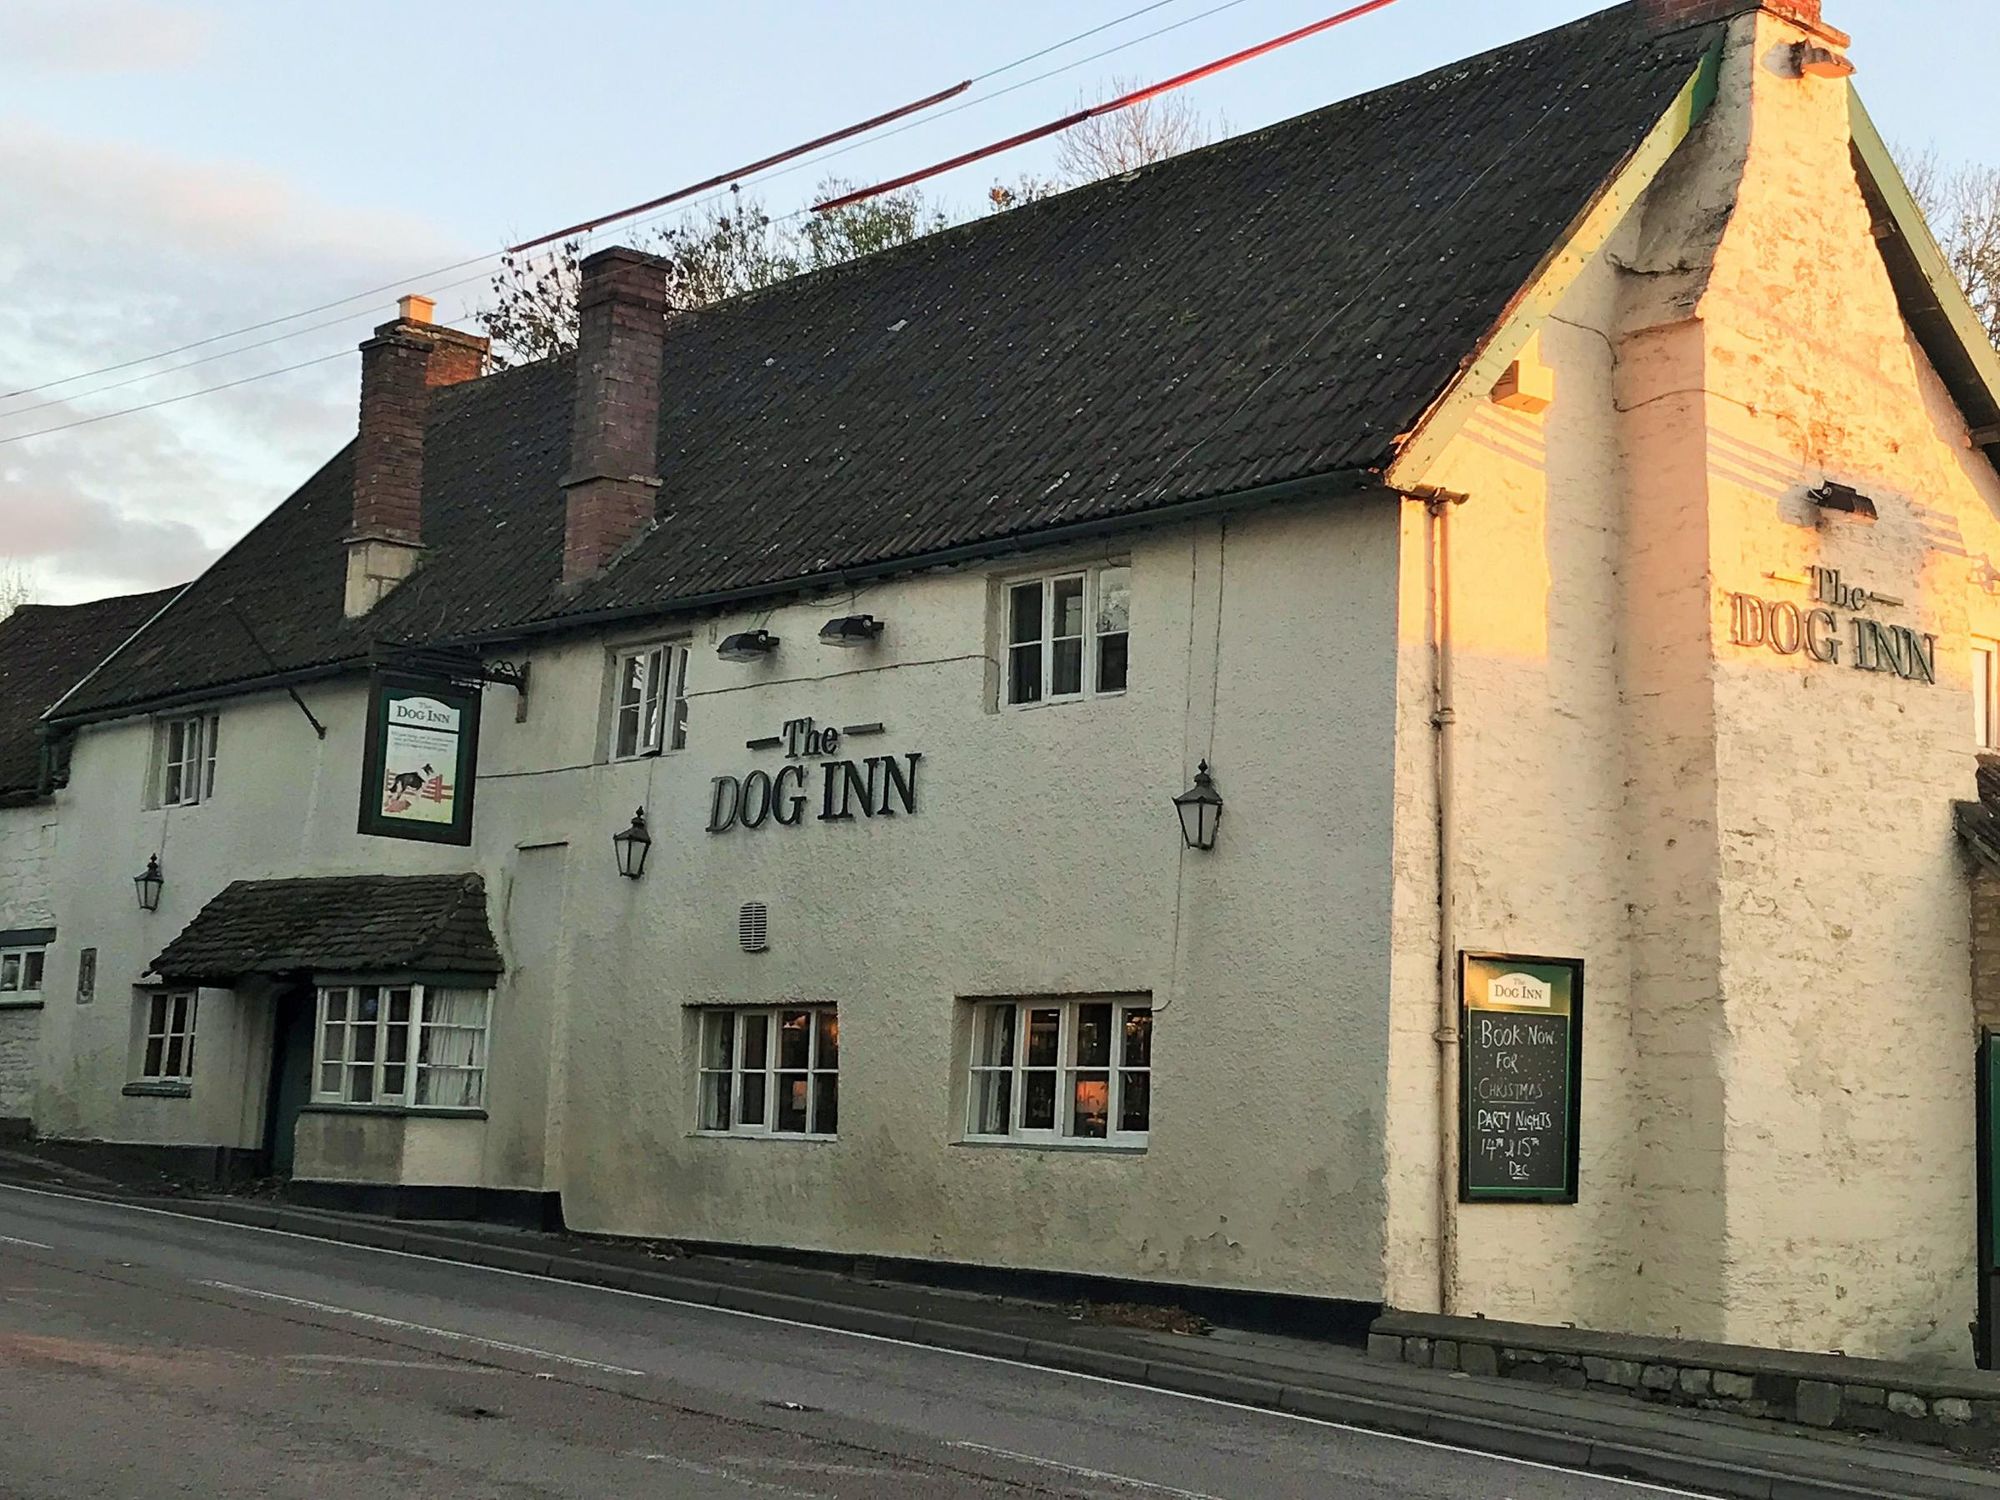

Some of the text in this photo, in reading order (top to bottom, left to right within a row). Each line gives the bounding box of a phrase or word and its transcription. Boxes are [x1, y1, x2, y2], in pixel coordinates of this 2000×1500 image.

[1811, 565, 1867, 611] The
[1727, 591, 1939, 685] DOG INN
[397, 705, 450, 723] DOG INN
[782, 716, 838, 759] The
[705, 752, 922, 833] DOG INN
[1521, 985, 1543, 1000] INN
[1481, 1019, 1555, 1049] BOOK NOW
[1496, 1051, 1519, 1074] FOR
[1479, 1077, 1544, 1100] CHRISTMAS
[1477, 1109, 1552, 1131] PARTY NIGHTS
[1509, 1160, 1530, 1177] DEC
